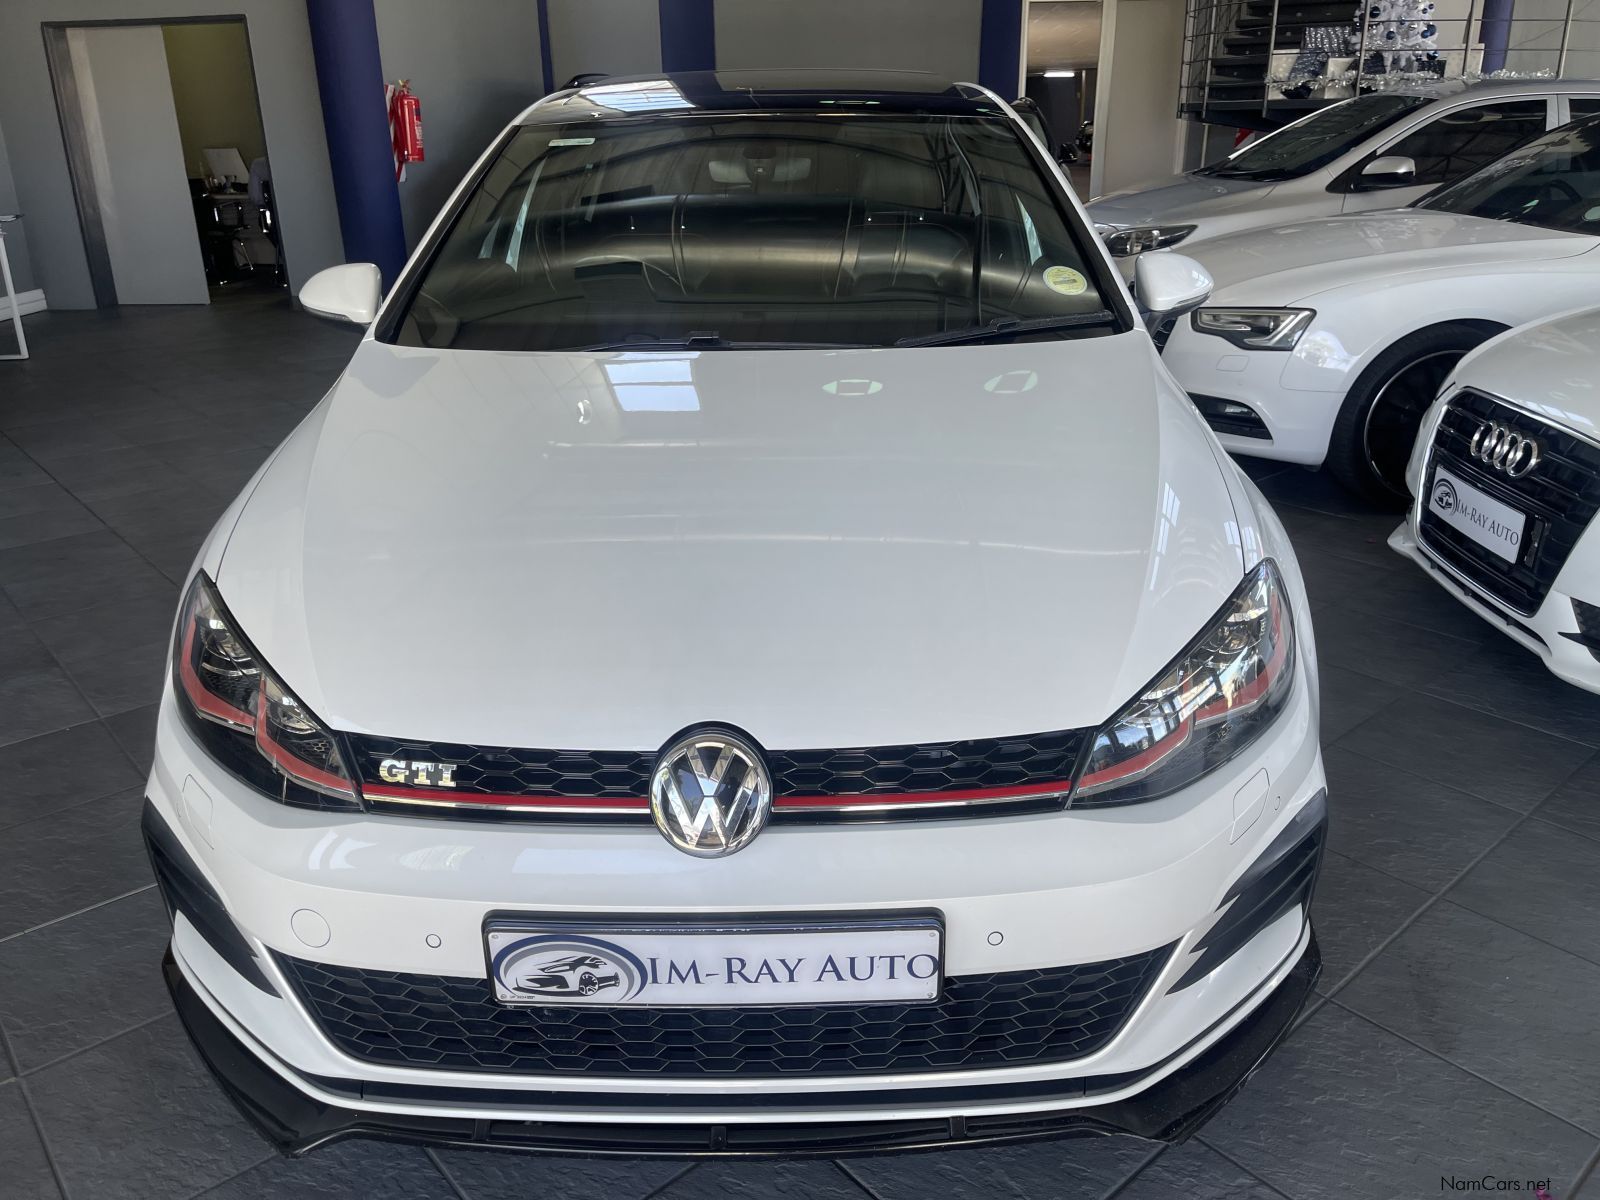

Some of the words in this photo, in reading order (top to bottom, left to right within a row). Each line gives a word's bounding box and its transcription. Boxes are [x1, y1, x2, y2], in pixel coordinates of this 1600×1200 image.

[1488, 520, 1519, 546] AUTO
[379, 759, 457, 787] GTI
[655, 737, 769, 853] VW
[648, 956, 806, 984] IM-RAY
[813, 953, 939, 982] AUTO
